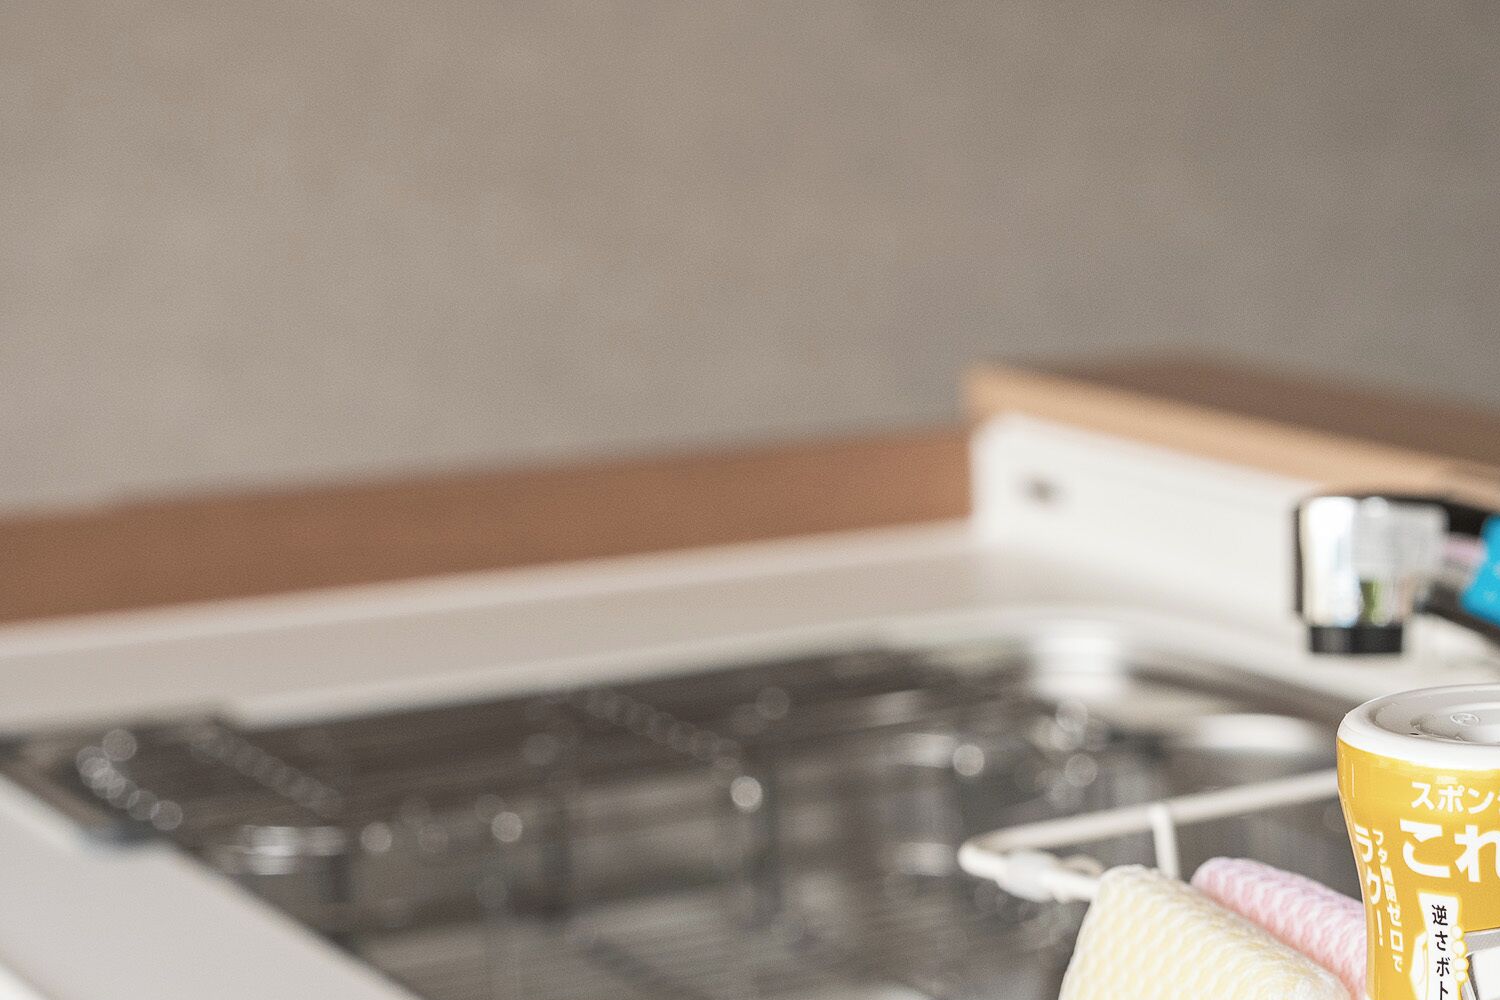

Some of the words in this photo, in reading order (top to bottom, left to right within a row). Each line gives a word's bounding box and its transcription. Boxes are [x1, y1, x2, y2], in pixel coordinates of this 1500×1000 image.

[1372, 828, 1404, 973] フタゼロで
